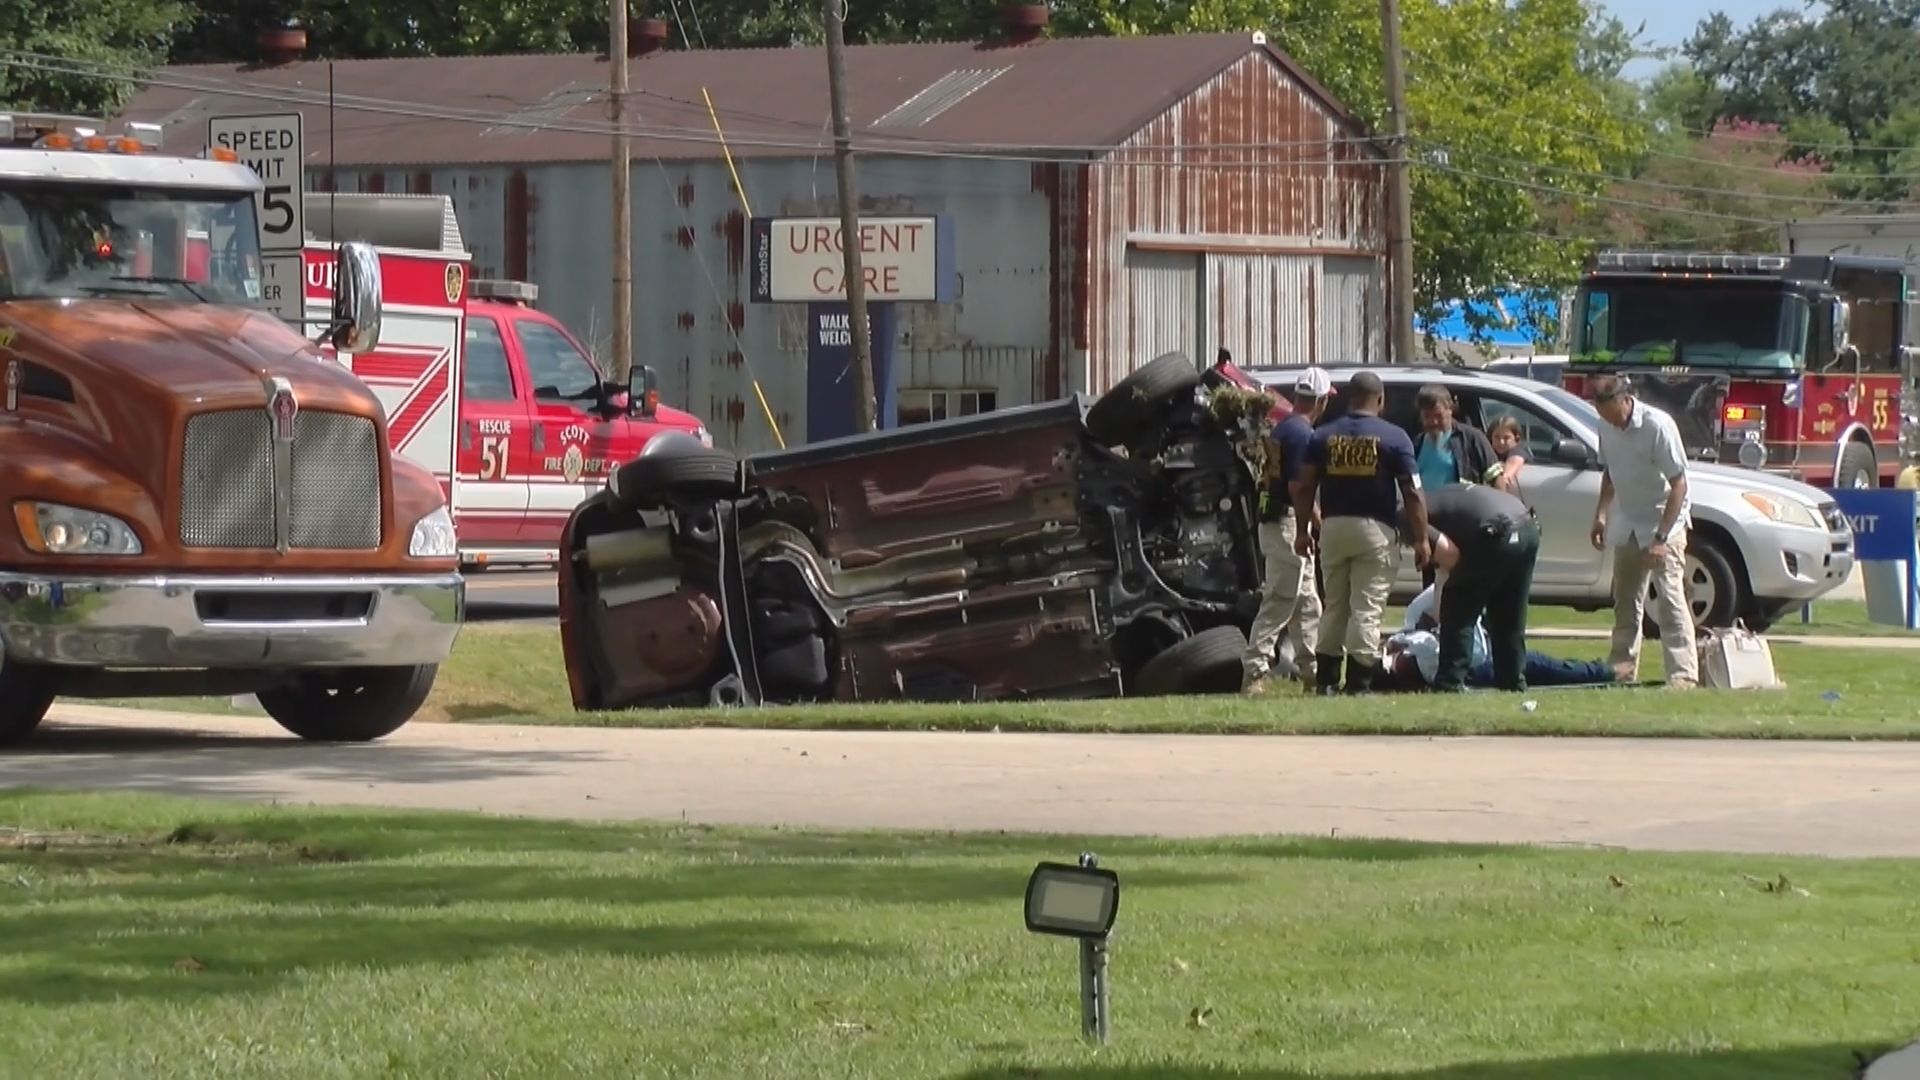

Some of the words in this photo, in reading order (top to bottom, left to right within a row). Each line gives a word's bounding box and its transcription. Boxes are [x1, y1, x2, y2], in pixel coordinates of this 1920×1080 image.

[217, 130, 294, 152] SPEED
[241, 157, 285, 179] MIT
[263, 185, 294, 234] 5
[758, 233, 769, 295] SouthStar
[1872, 399, 1888, 430] 55
[479, 419, 511, 434] RESCUE
[560, 424, 590, 445] SCOTT
[480, 437, 508, 480] 51
[544, 456, 562, 470] FIRE
[1847, 514, 1879, 533] XIT
